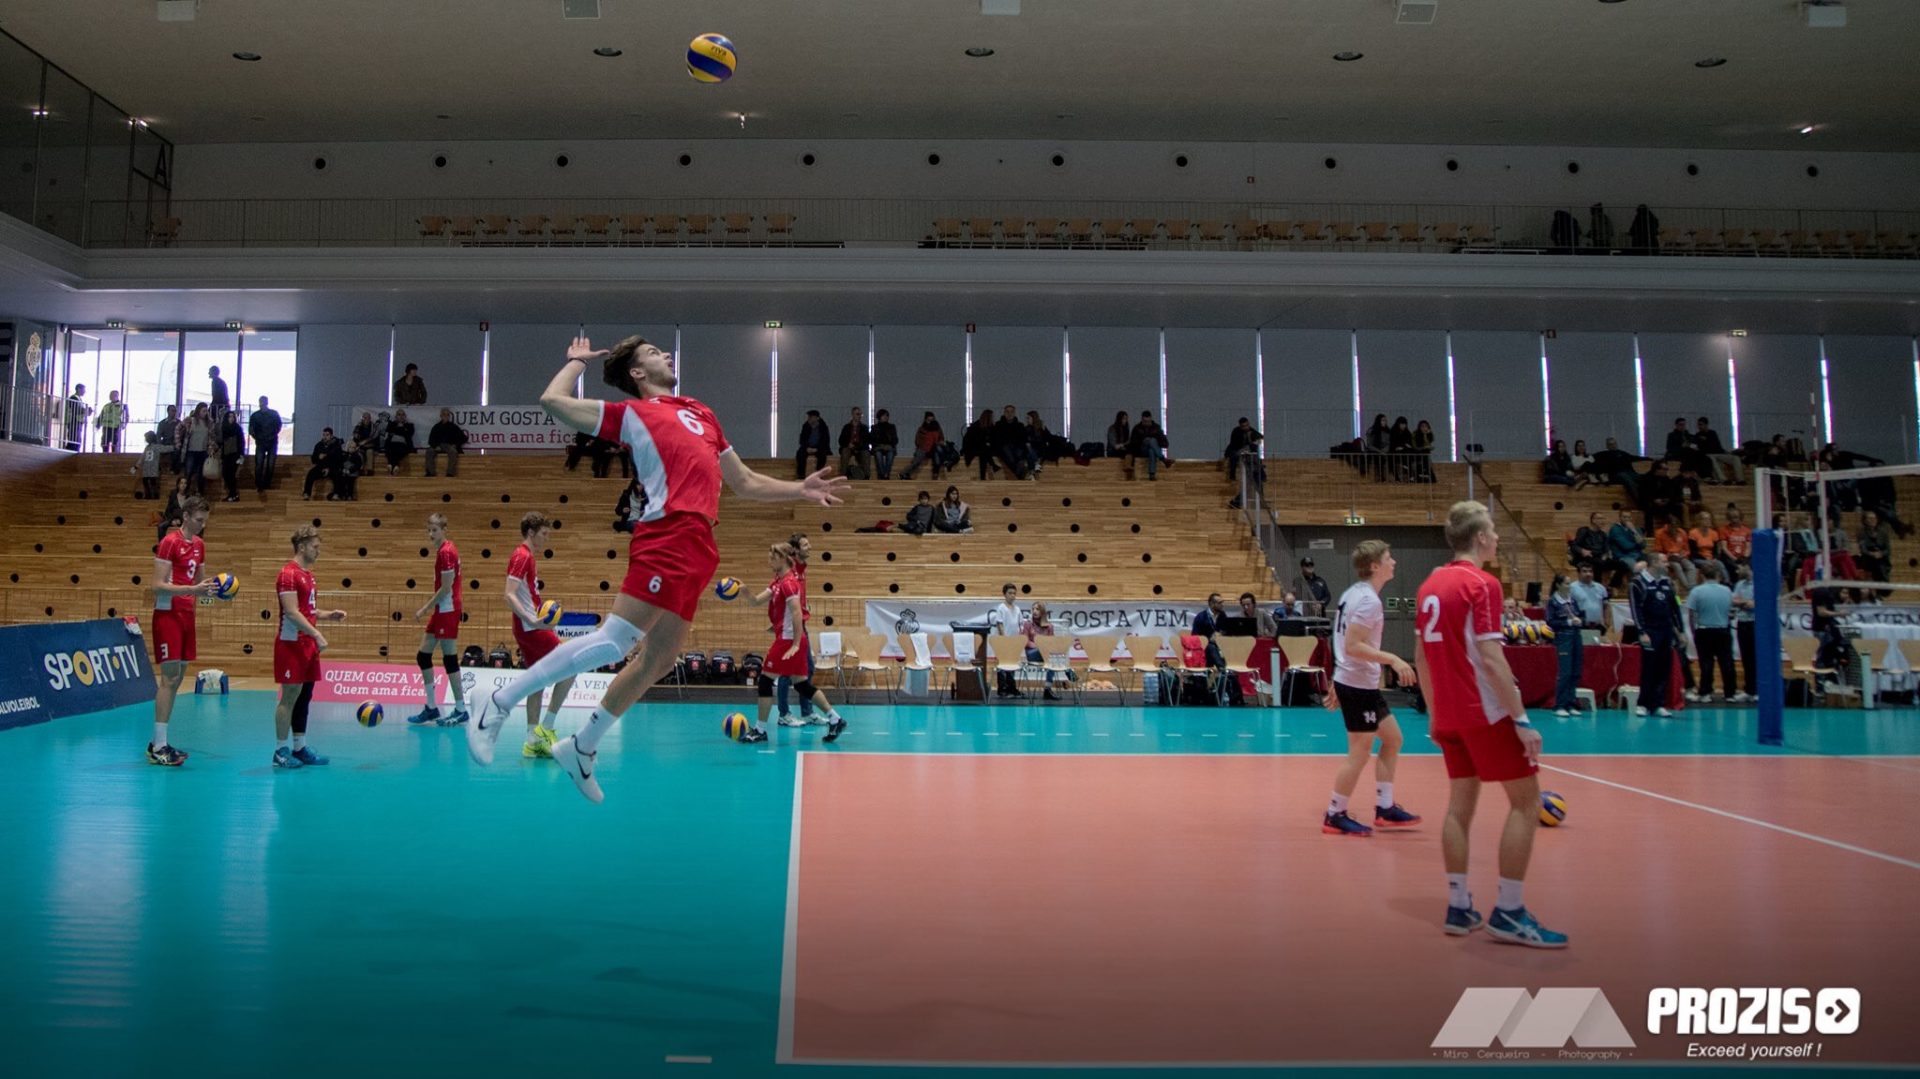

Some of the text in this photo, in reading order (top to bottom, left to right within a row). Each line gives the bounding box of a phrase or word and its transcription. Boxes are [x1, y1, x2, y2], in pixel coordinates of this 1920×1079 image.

[500, 411, 556, 425] GOSTA
[677, 409, 705, 436] 6
[510, 433, 544, 443] ama
[186, 559, 196, 579] 3
[649, 575, 662, 593] 6
[1059, 610, 1131, 628] GOSTA
[1136, 609, 1189, 627] VEM
[1336, 601, 1346, 635] 1
[1421, 595, 1443, 642] 2
[160, 643, 168, 659] 3
[284, 669, 291, 679] 4
[325, 670, 443, 685] QUEM GOSTA VM
[334, 683, 368, 695] Quem
[371, 686, 398, 696] ama
[1363, 711, 1377, 723] 14
